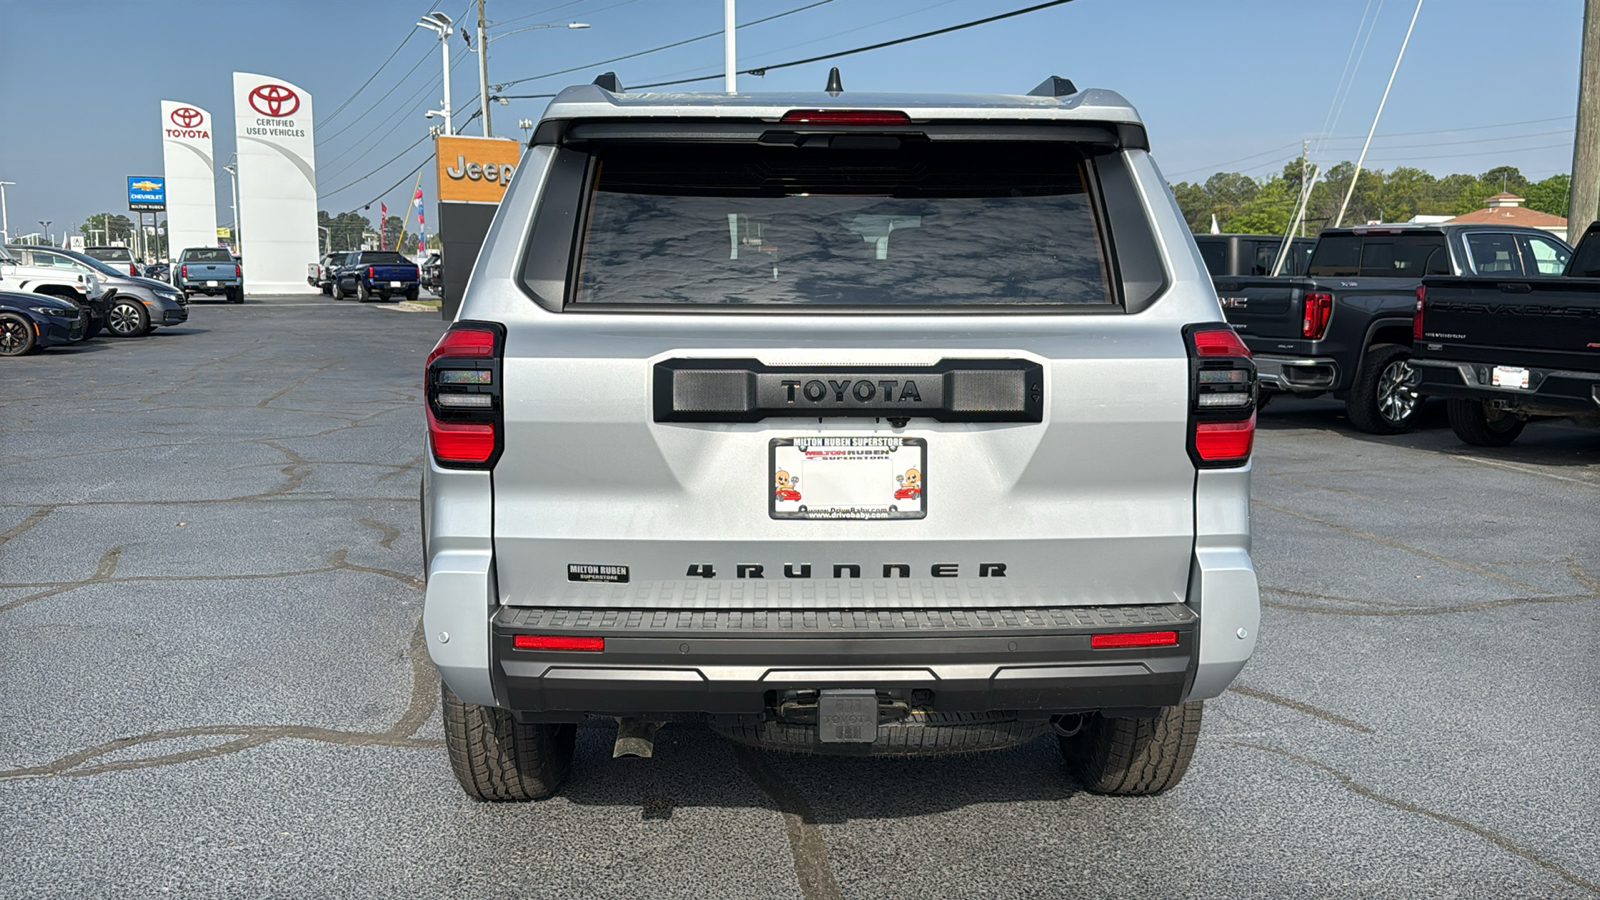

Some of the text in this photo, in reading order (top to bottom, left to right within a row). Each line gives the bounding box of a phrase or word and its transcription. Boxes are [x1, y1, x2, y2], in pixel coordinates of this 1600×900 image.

[256, 118, 295, 128] CERTIFIED
[165, 128, 210, 140] TOYOTA
[246, 127, 305, 138] USED VEHICLES
[446, 155, 515, 186] Jeep
[1219, 297, 1248, 308] MC
[780, 380, 923, 404] TOYOTA
[793, 437, 904, 447] MILTON RUBEN SUPERSTORE
[570, 564, 627, 575] MILTON RUBEN
[686, 562, 1007, 578] 4RUNNER
[822, 713, 873, 726] TOYOTA
